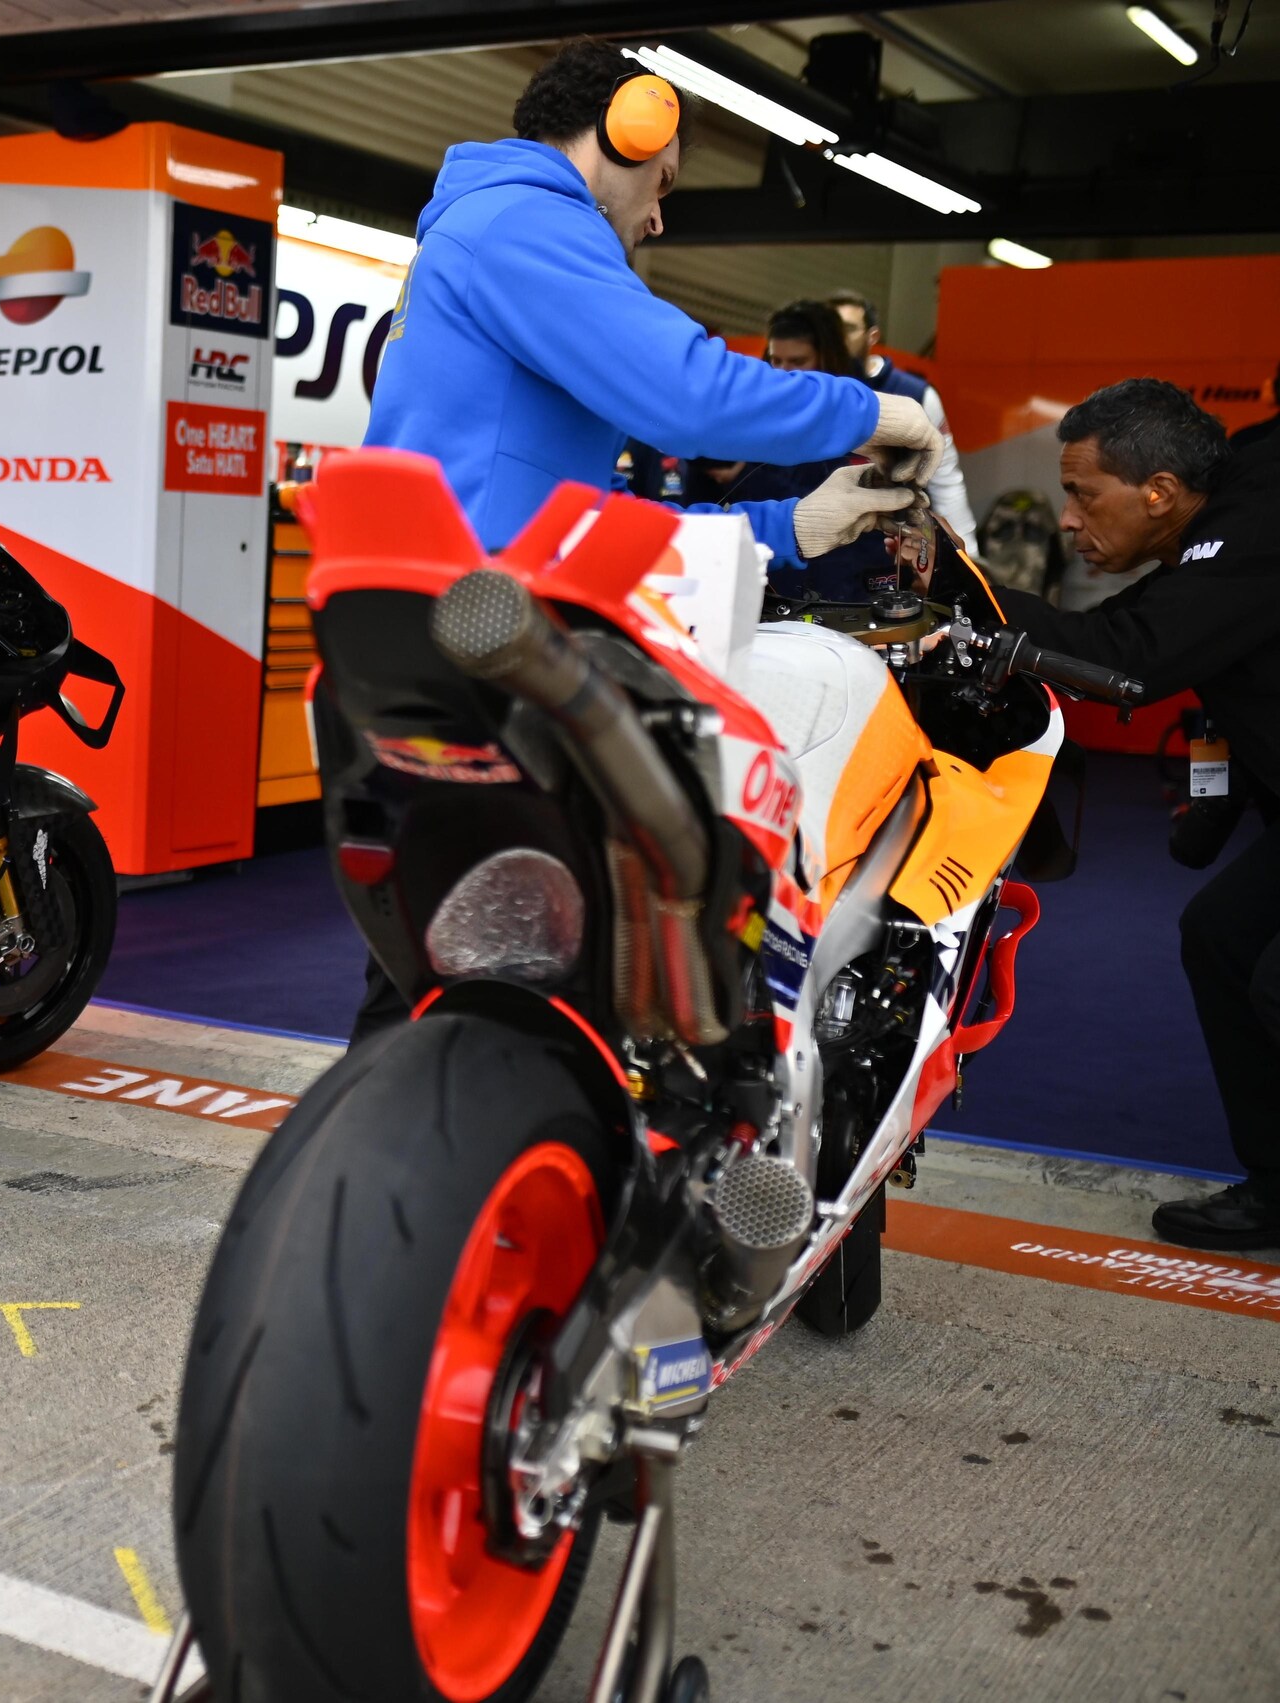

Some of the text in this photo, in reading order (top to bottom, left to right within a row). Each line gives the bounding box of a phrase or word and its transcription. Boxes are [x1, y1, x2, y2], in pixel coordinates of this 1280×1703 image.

[181, 274, 261, 324] Red Bull
[191, 347, 250, 384] HRC
[275, 287, 396, 405] PS
[175, 418, 256, 452] One HEART.
[186, 449, 214, 475] Satu
[741, 750, 797, 828] One
[58, 1067, 297, 1127] ANE
[1010, 1242, 1205, 1282] RICARDO
[1107, 1249, 1264, 1283] TORMO
